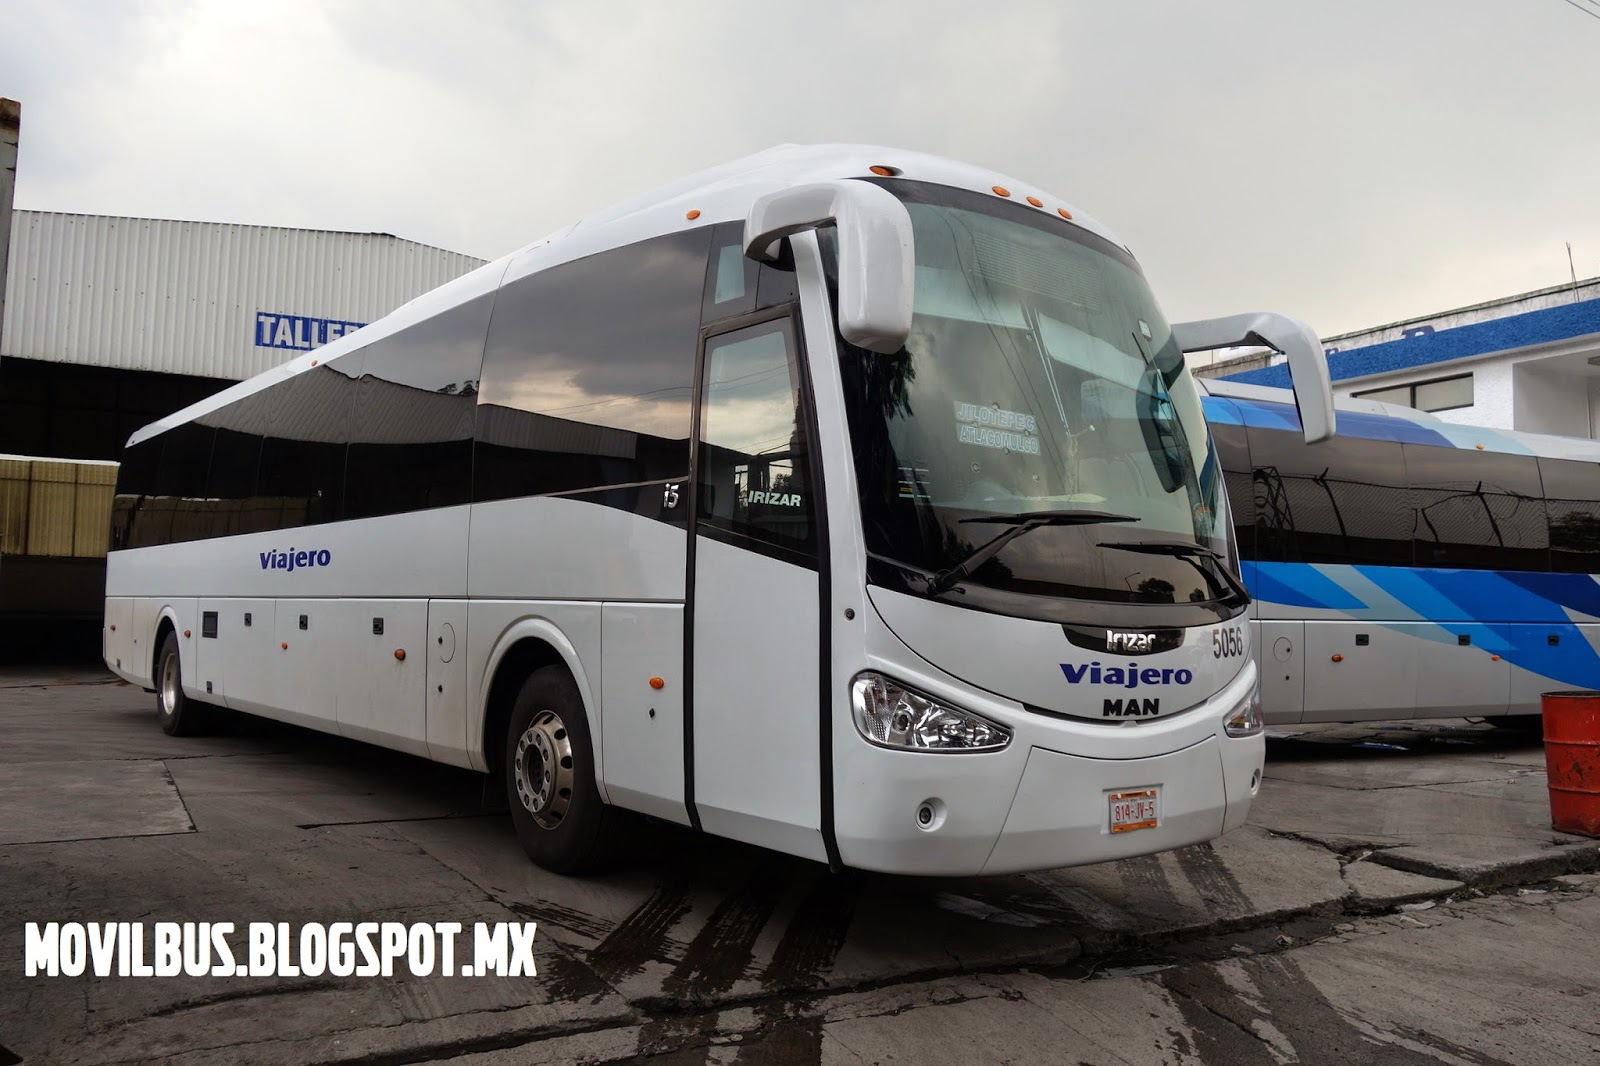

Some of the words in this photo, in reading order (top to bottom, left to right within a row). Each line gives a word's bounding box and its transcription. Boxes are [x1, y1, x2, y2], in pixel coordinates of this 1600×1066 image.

[258, 315, 360, 349] TALLE
[956, 403, 1035, 432] JILOTEPEC
[959, 425, 1039, 454] ATLACOMULCO
[663, 483, 680, 509] i5
[748, 490, 802, 507] IRIZAR
[1212, 627, 1243, 659] 5056
[1059, 661, 1193, 689] Viajero
[1102, 698, 1160, 717] MAN
[1115, 800, 1155, 821] 814-JV-5
